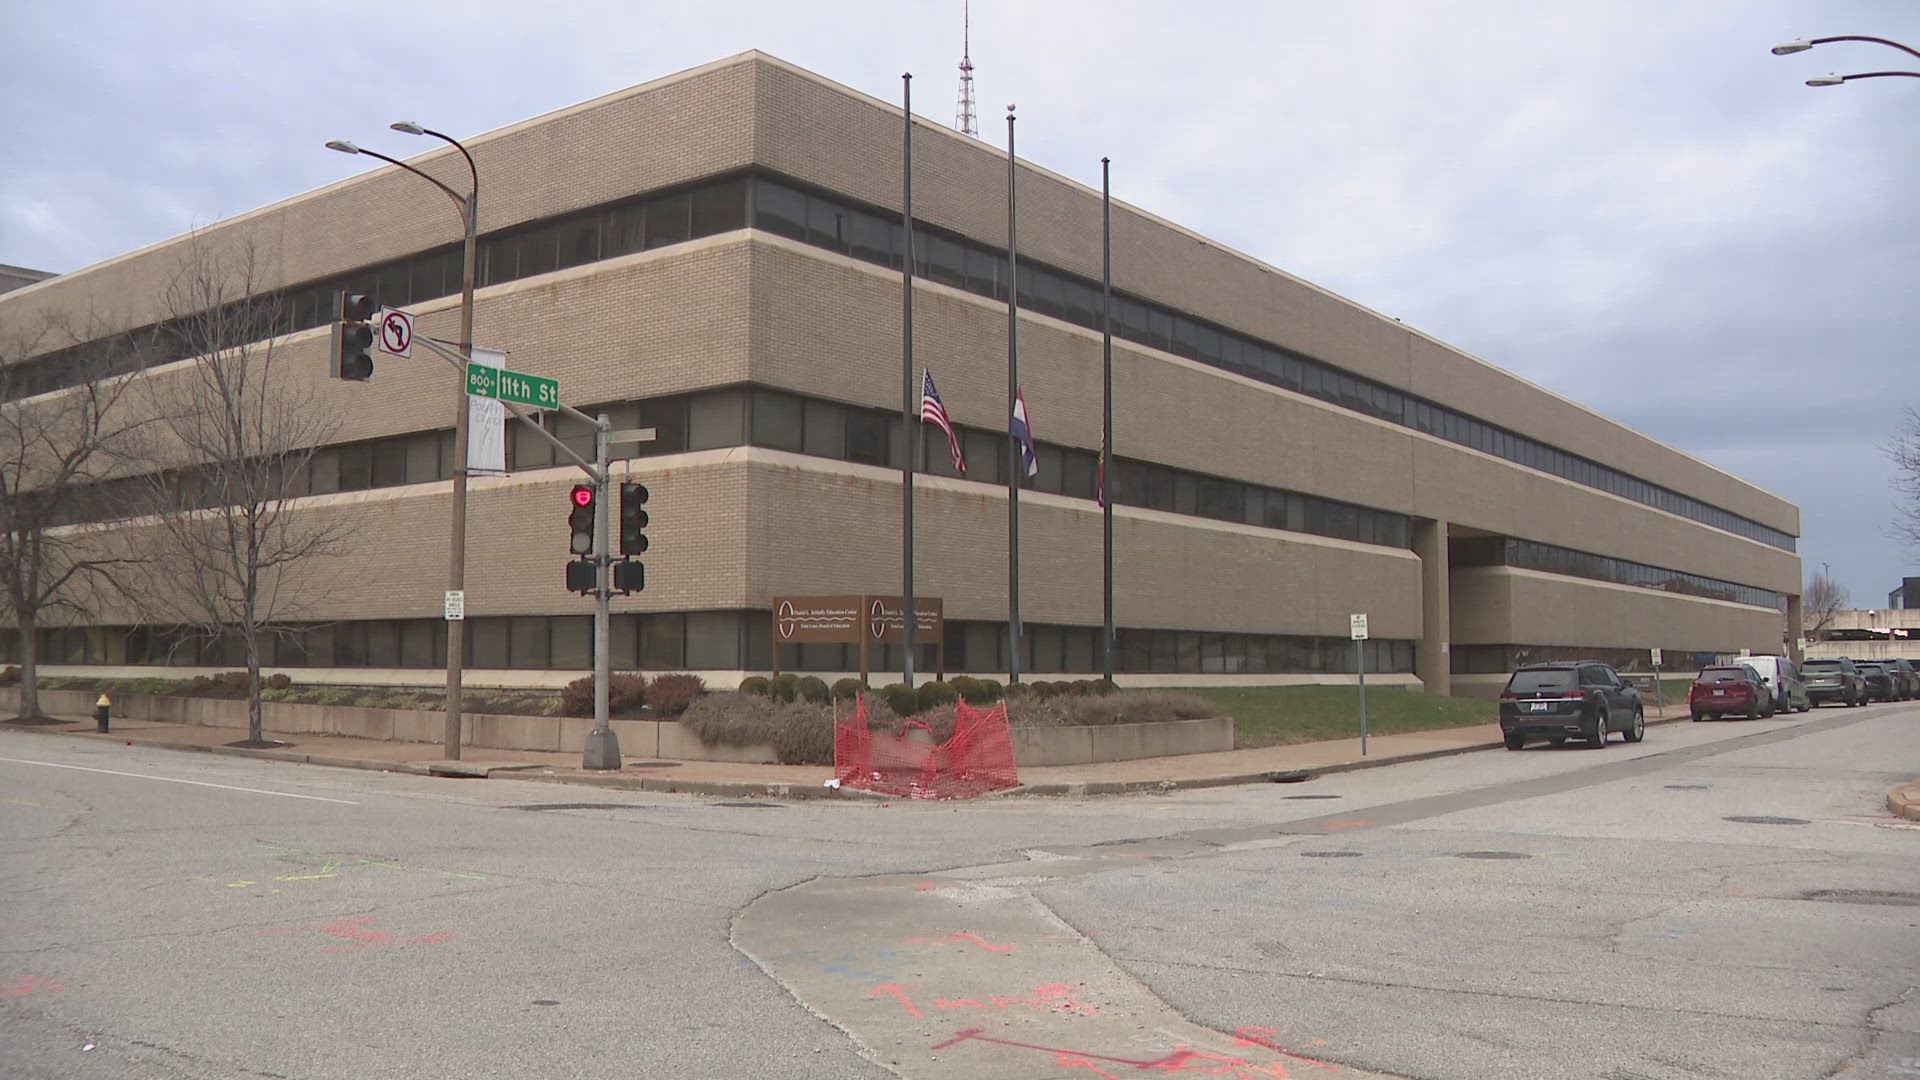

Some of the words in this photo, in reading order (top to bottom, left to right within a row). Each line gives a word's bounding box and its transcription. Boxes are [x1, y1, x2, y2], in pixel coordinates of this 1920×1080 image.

[470, 374, 490, 387] 800
[502, 376, 531, 399] 11th
[539, 383, 556, 404] St
